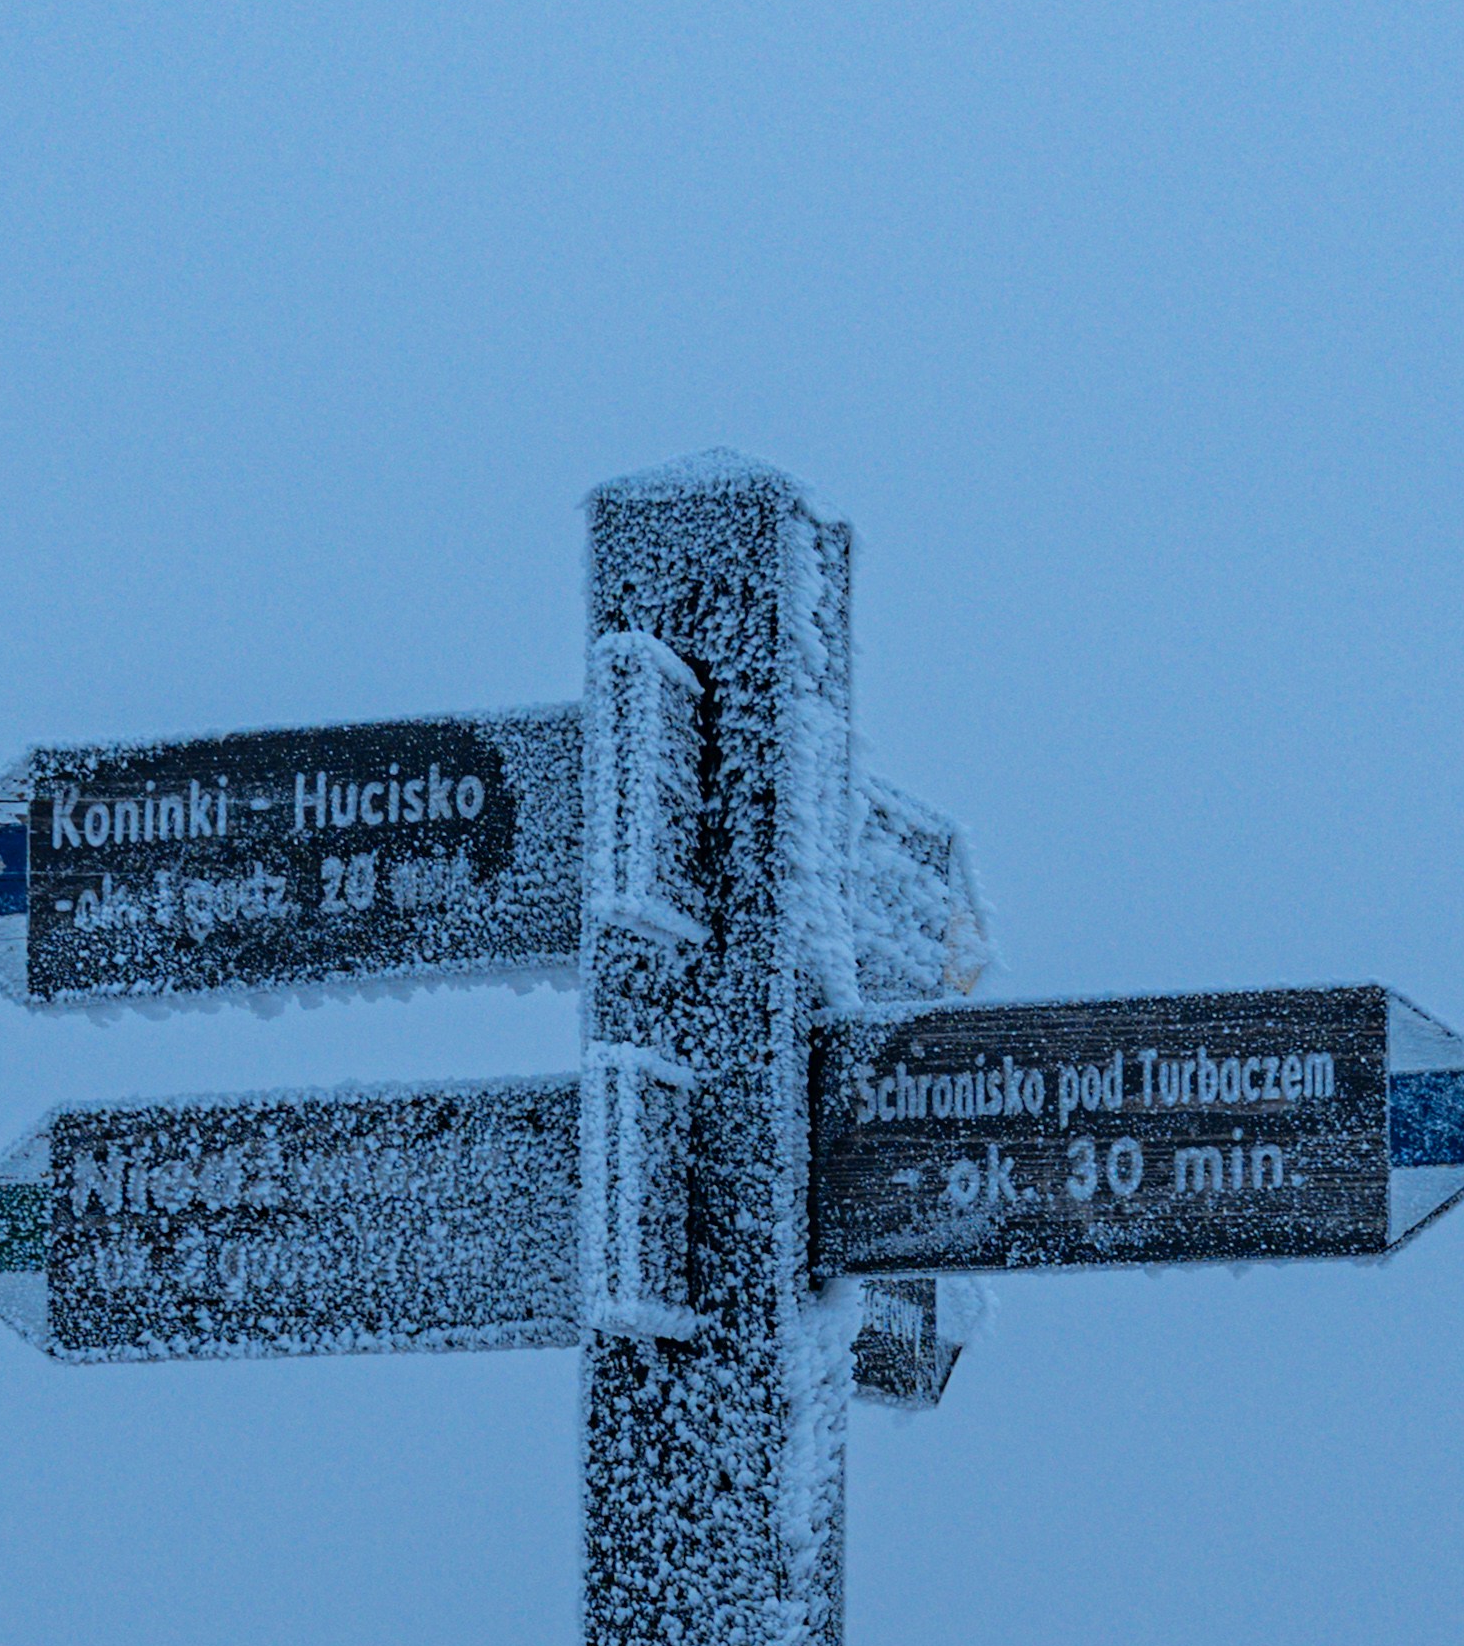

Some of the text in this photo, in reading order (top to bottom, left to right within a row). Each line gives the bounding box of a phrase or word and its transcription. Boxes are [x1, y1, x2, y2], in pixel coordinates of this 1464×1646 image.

[51, 773, 229, 850] Koninki
[294, 761, 486, 832] Hucisko
[855, 1044, 1335, 1130] Schronisko pod Turbaczem
[1064, 1133, 1144, 1201] 30
